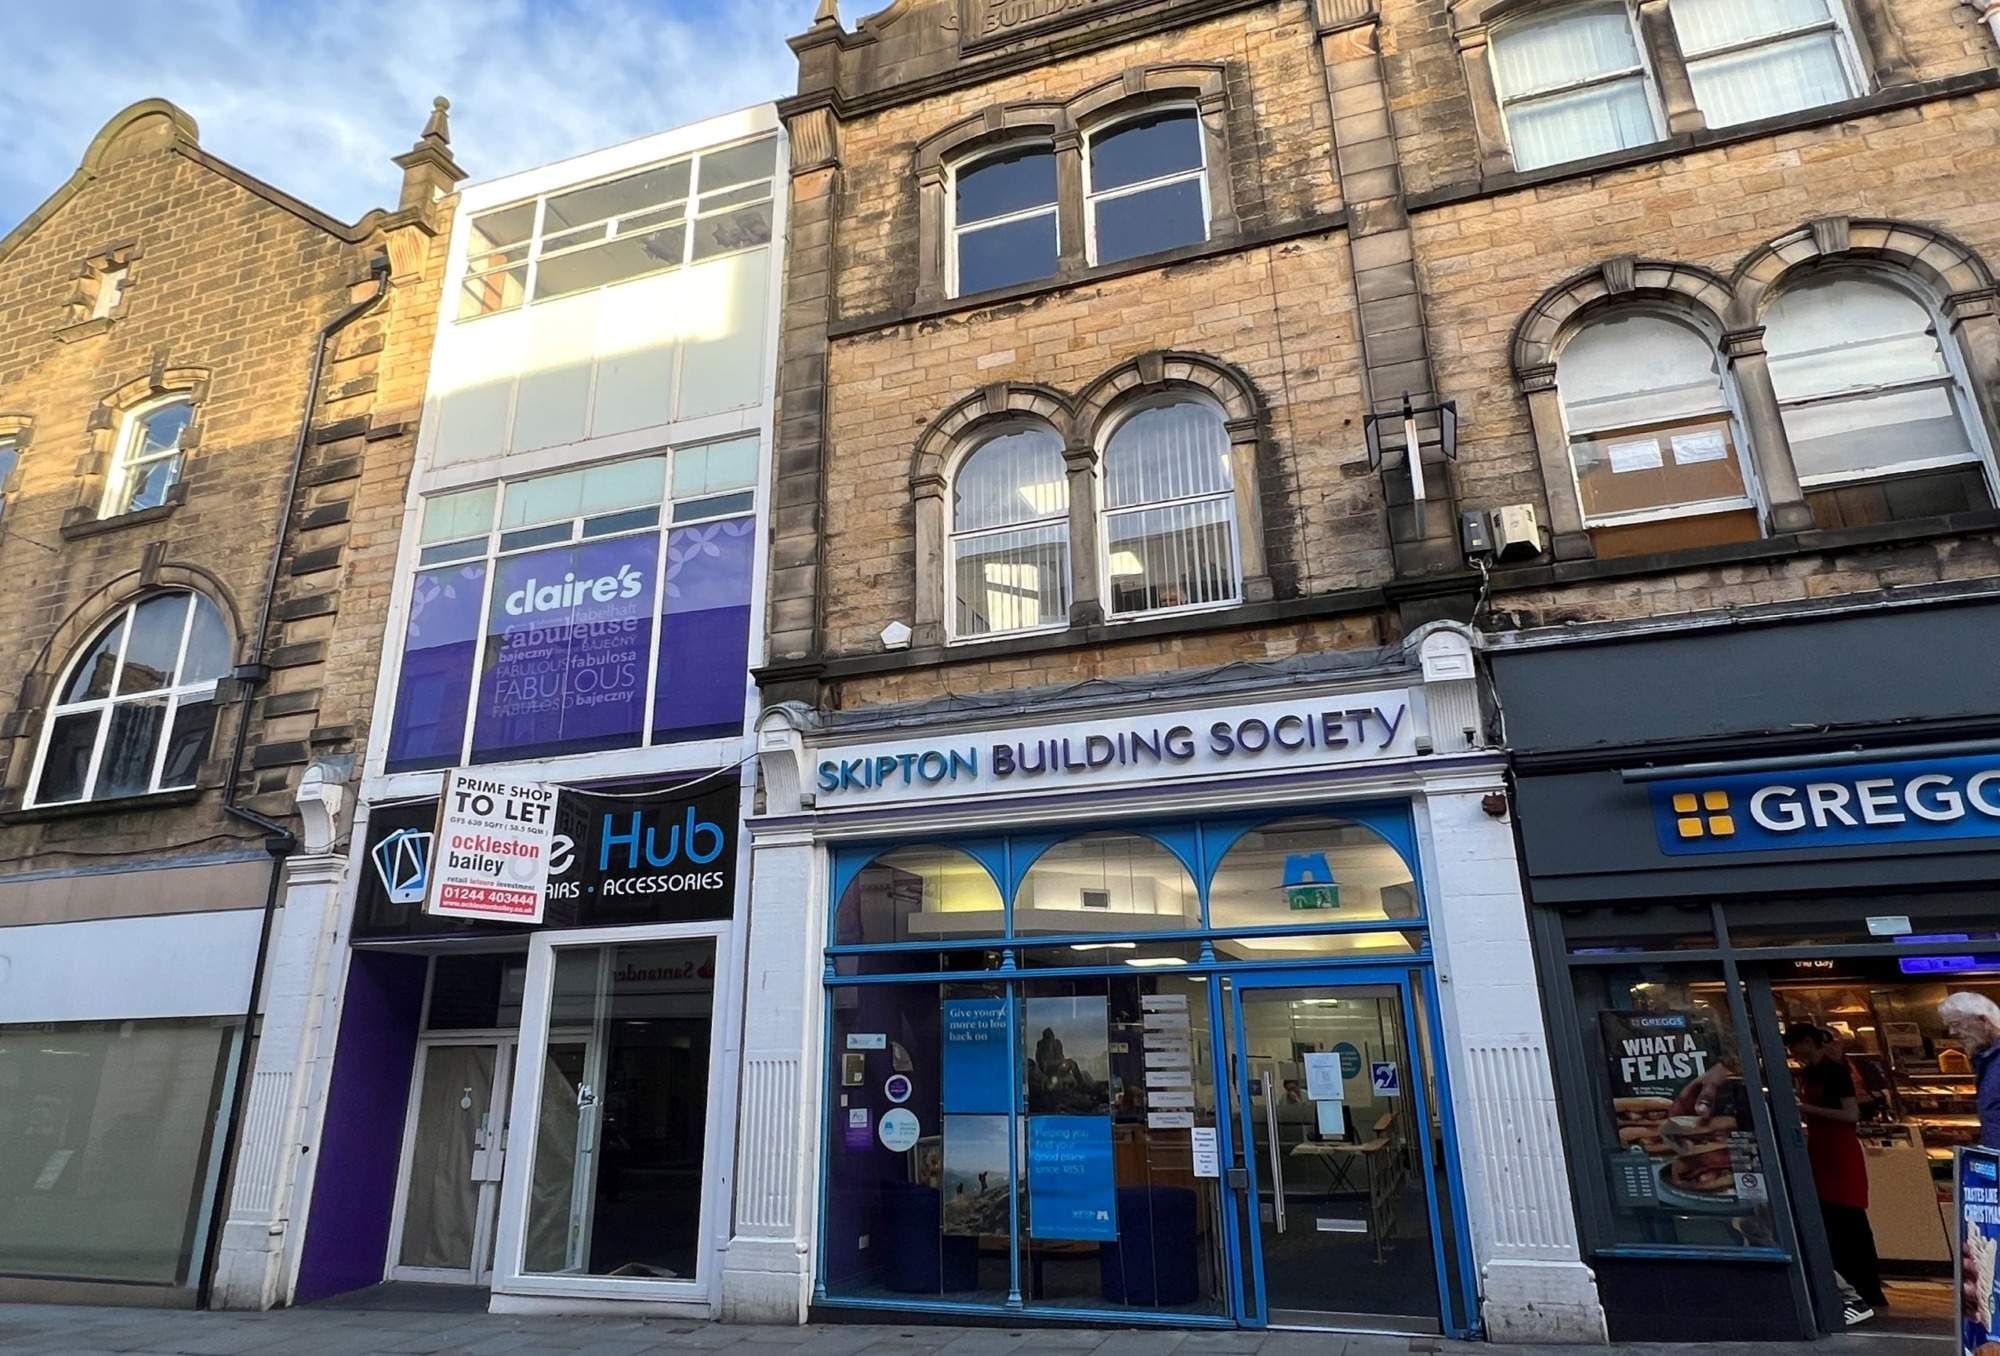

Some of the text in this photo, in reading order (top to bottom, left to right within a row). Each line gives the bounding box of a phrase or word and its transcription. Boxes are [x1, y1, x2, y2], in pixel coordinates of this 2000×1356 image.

[505, 564, 644, 616] claire's
[500, 616, 639, 650] fabuleuse
[496, 658, 569, 679] FABULOUS
[498, 647, 554, 665] bajeczny
[570, 650, 638, 669] fabulosa
[495, 663, 636, 704] FABULOUS
[576, 690, 635, 707] bajeczny
[817, 704, 1406, 792] SKIPTON BUILDING SOCIETY
[457, 777, 553, 802] PRIME SHOP
[455, 791, 494, 816] TO
[505, 800, 551, 825] LET
[484, 821, 503, 830] SQFT
[451, 834, 540, 859] ockleston
[600, 806, 725, 871] Hub
[449, 851, 505, 876] bailey
[444, 887, 534, 906] 01244 403444
[496, 882, 536, 891] investment
[545, 871, 724, 900] AIRS ACCESSORIES
[949, 1008, 971, 1017] Give
[949, 1019, 1007, 1029] more to loo
[1641, 1017, 1684, 1027] GREGGS
[949, 1031, 973, 1041] back
[1622, 1033, 1697, 1057] WHAT A
[1620, 1051, 1708, 1084] FEAST
[1963, 1187, 1985, 1203] TASTES
